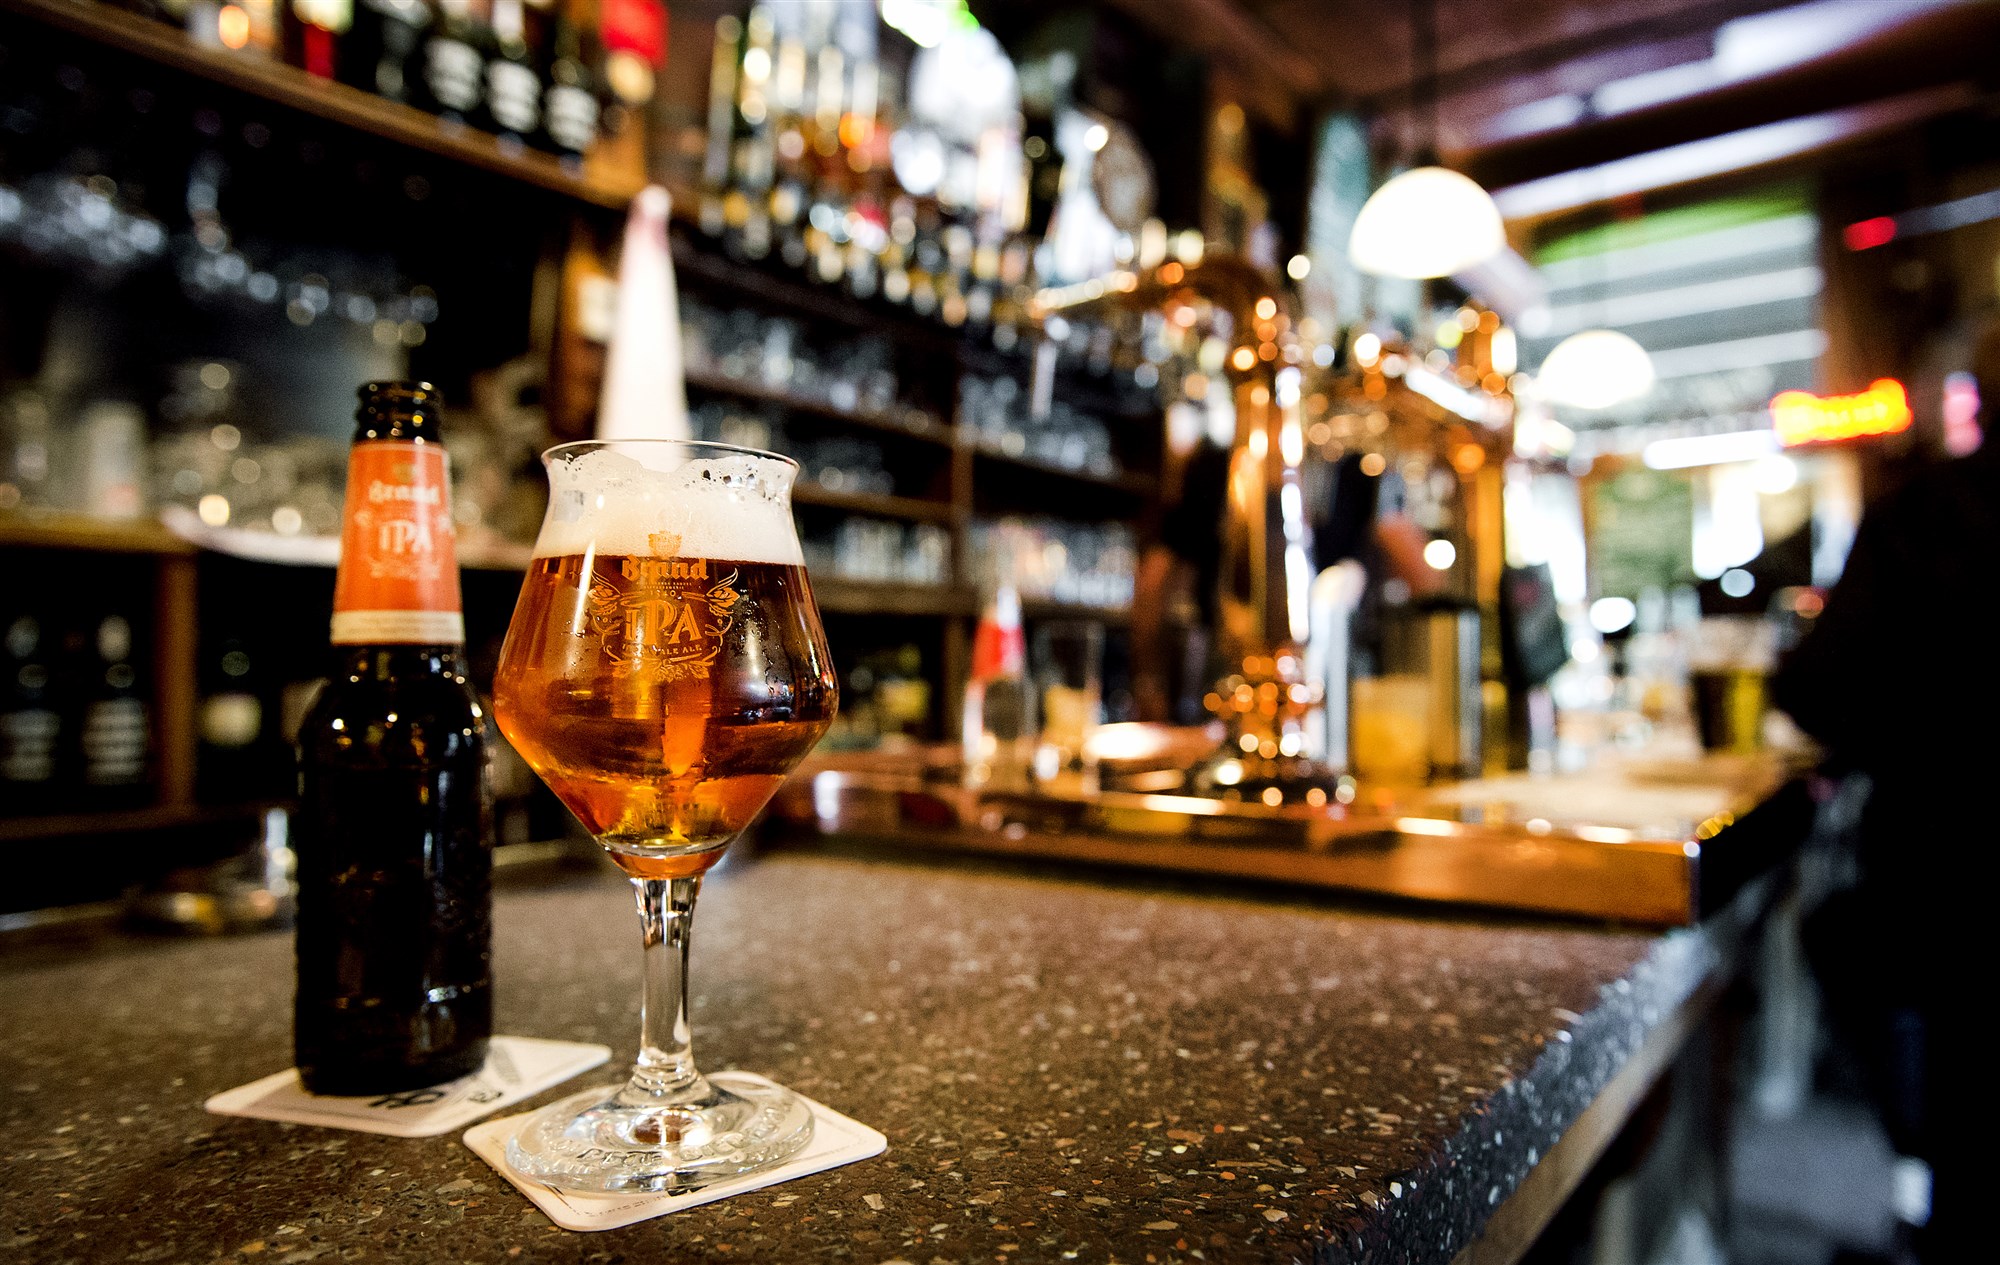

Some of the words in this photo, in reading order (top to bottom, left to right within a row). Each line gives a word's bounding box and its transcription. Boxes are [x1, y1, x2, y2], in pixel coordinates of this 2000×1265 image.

[378, 519, 433, 554] IPA
[622, 554, 709, 580] Brand
[621, 600, 702, 645] IPA
